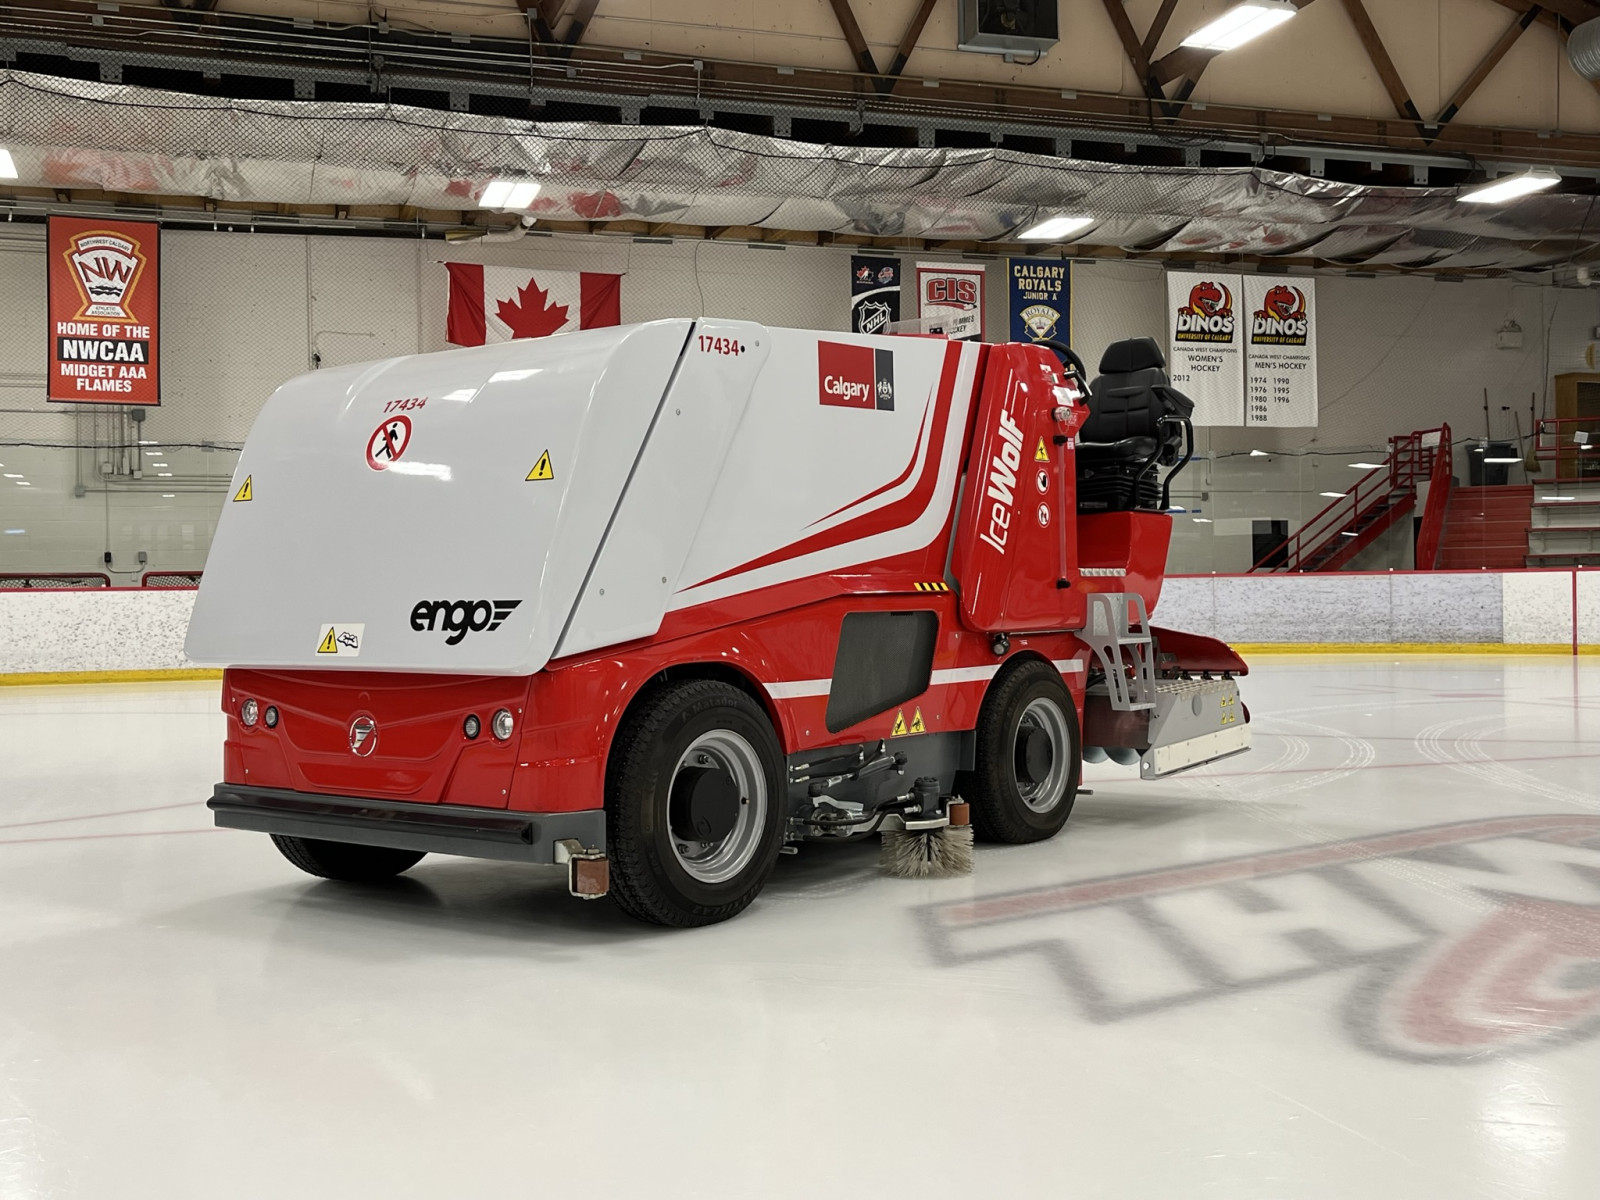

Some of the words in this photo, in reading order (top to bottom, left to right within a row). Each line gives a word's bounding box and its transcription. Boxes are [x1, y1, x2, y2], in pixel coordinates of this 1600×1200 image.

[78, 257, 132, 284] NW
[1014, 265, 1065, 279] CALGARY
[926, 278, 978, 305] CIS
[1018, 278, 1062, 292] ROYALS
[1023, 291, 1048, 300] JUNIOR
[1025, 307, 1055, 318] ROYALS
[866, 311, 886, 332] NHL
[1177, 313, 1234, 333] DINOS
[1252, 317, 1307, 336] DINOS
[57, 322, 98, 336] HOME
[102, 324, 120, 337] OF
[124, 325, 150, 339] THE
[1177, 333, 1204, 341] UNIVERSITY
[1211, 334, 1232, 342] CALGARY
[63, 339, 144, 362] NWCAA
[699, 335, 739, 356] 17434
[1188, 355, 1223, 363] WOMEN'S
[1255, 361, 1277, 369] MEN'S
[1279, 362, 1307, 370] HOCKEY
[61, 363, 115, 378] MIDGET
[119, 366, 147, 379] AAA
[1191, 364, 1221, 372] HOCKEY
[76, 378, 132, 393] FLAMES
[1173, 374, 1190, 382] 2012
[1250, 376, 1267, 384] 1974
[1273, 377, 1290, 385] 1990
[824, 375, 870, 402] Calgary
[1250, 386, 1268, 394] 1976
[1273, 387, 1290, 395] 1995
[383, 396, 429, 413] 17434
[1250, 395, 1268, 403] 1980
[1273, 396, 1290, 404] 1996
[980, 409, 1024, 555] IceWolf
[410, 600, 492, 646] engo
